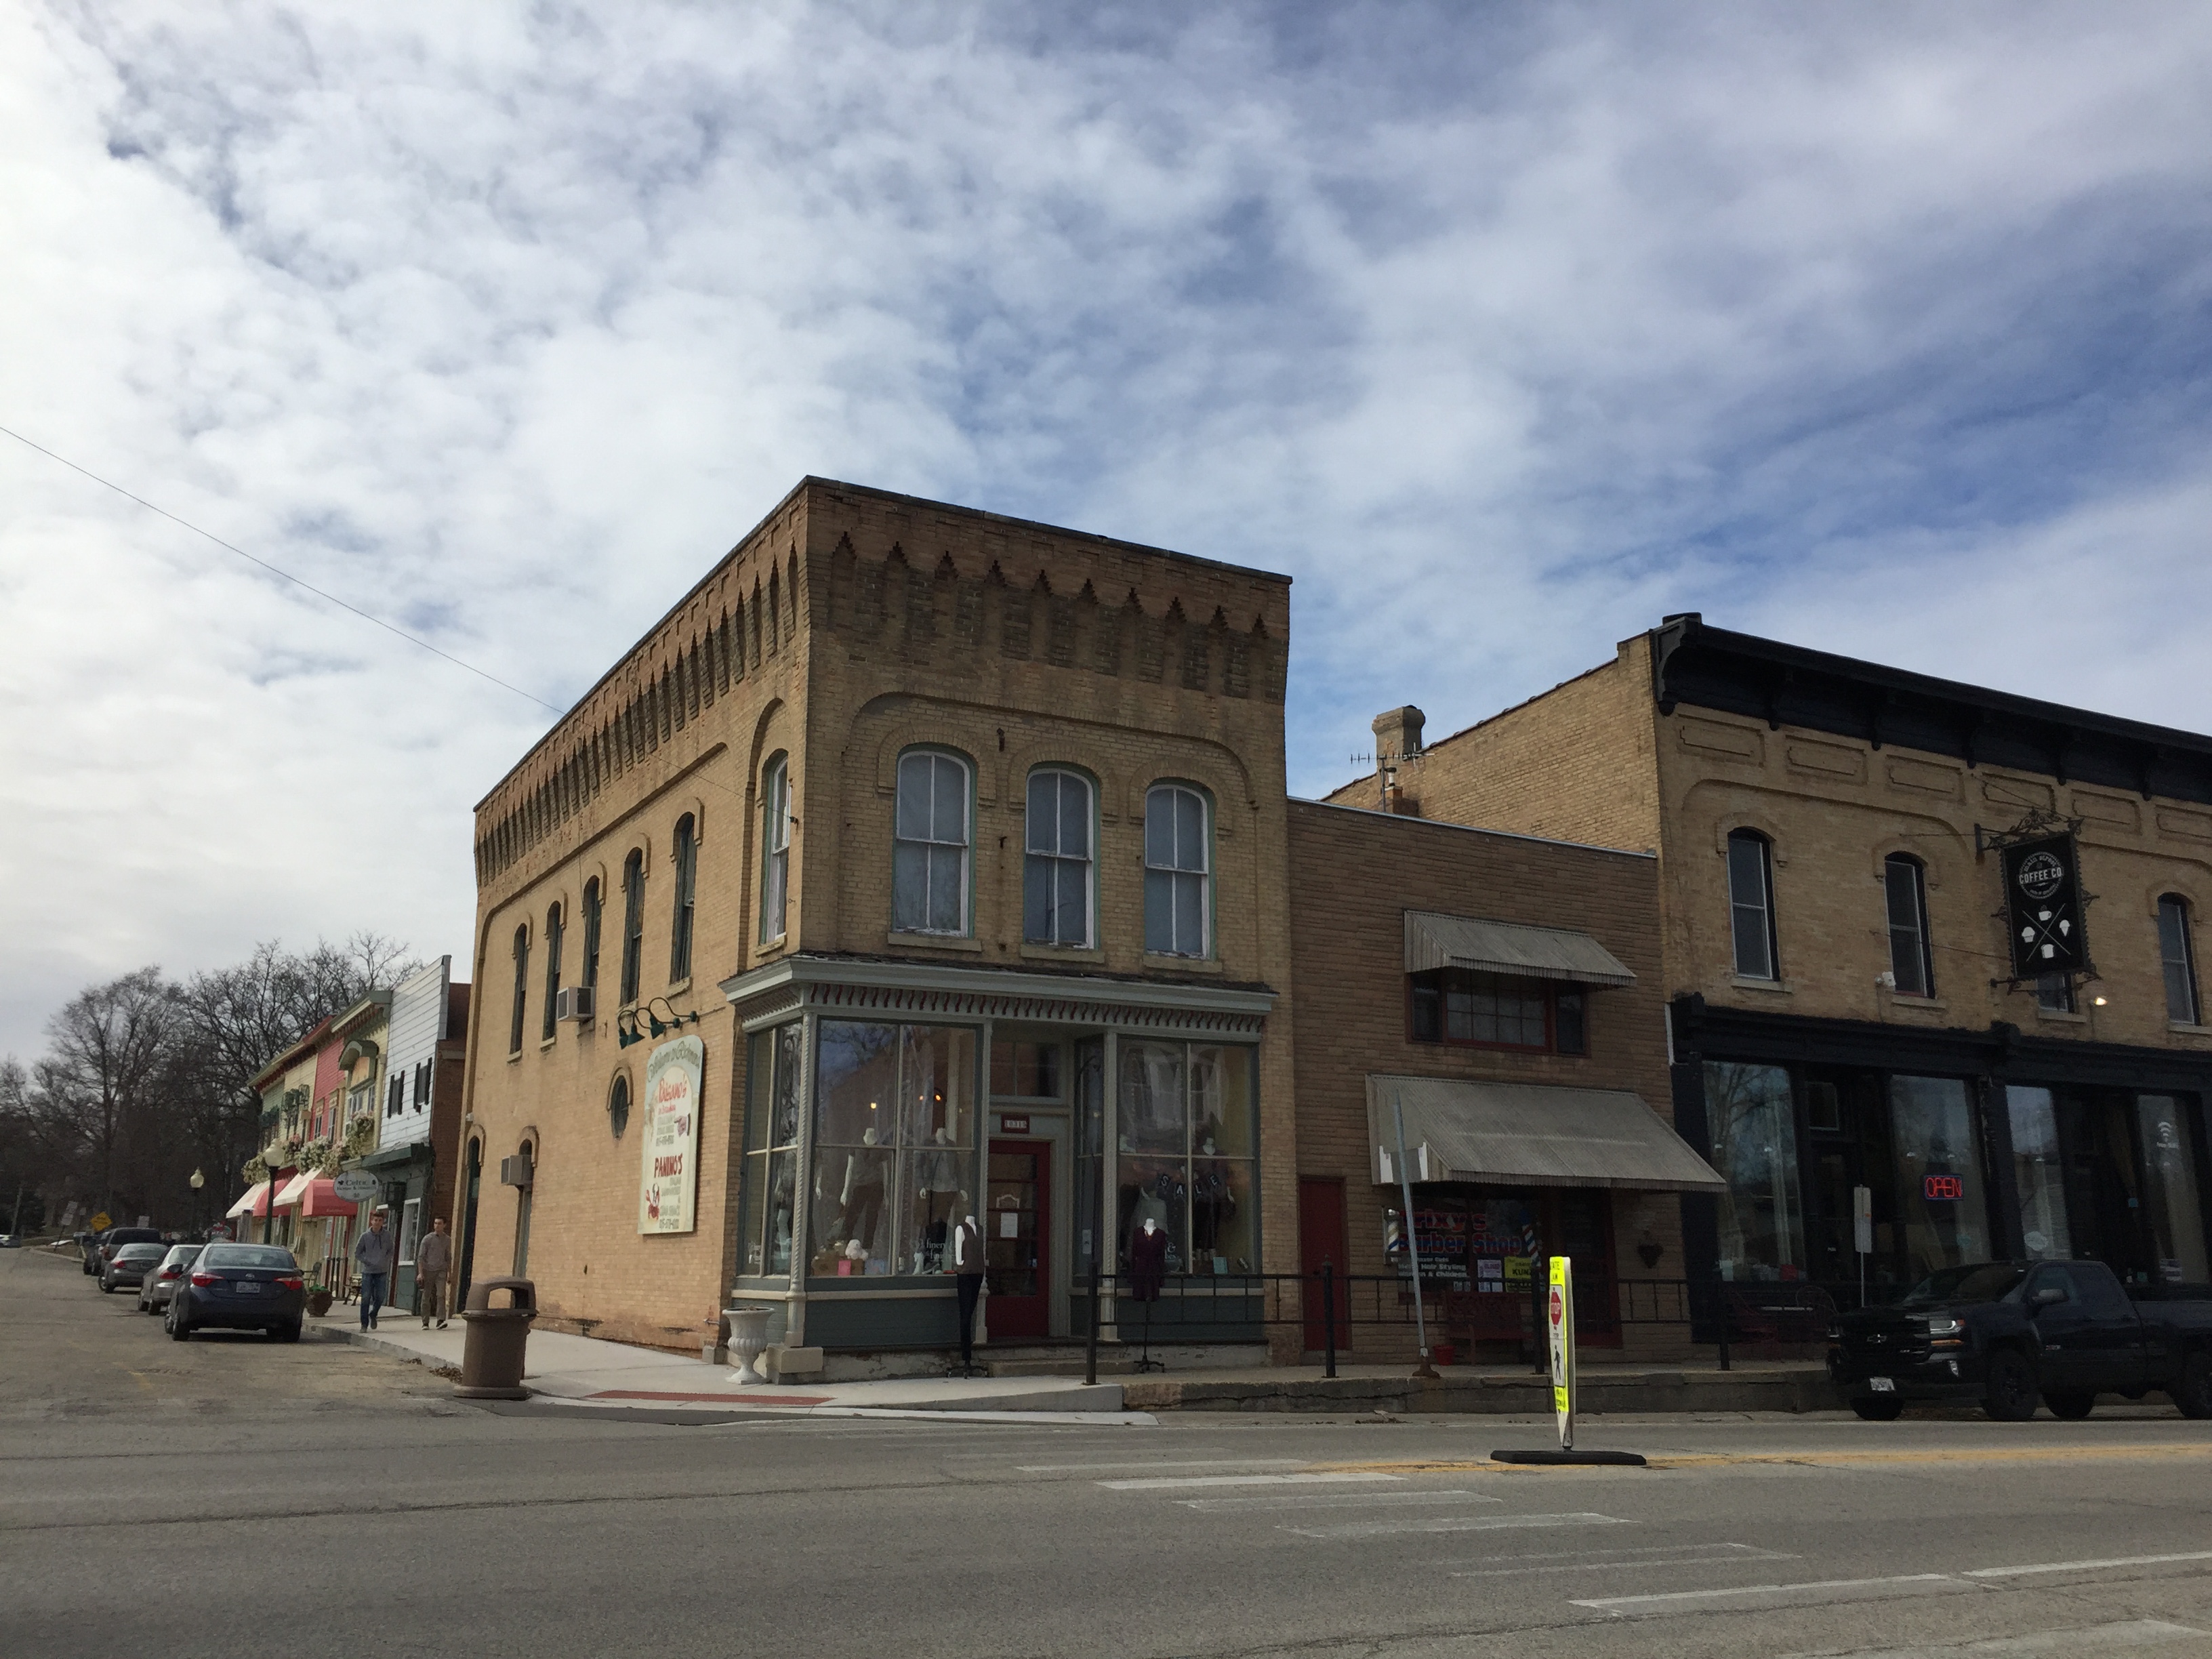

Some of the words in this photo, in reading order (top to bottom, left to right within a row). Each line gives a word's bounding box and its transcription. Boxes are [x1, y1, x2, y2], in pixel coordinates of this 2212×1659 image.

[2019, 869, 2049, 884] COFFEE
[1925, 1176, 1962, 1197] OPEN
[1472, 1232, 1522, 1254] Shop
